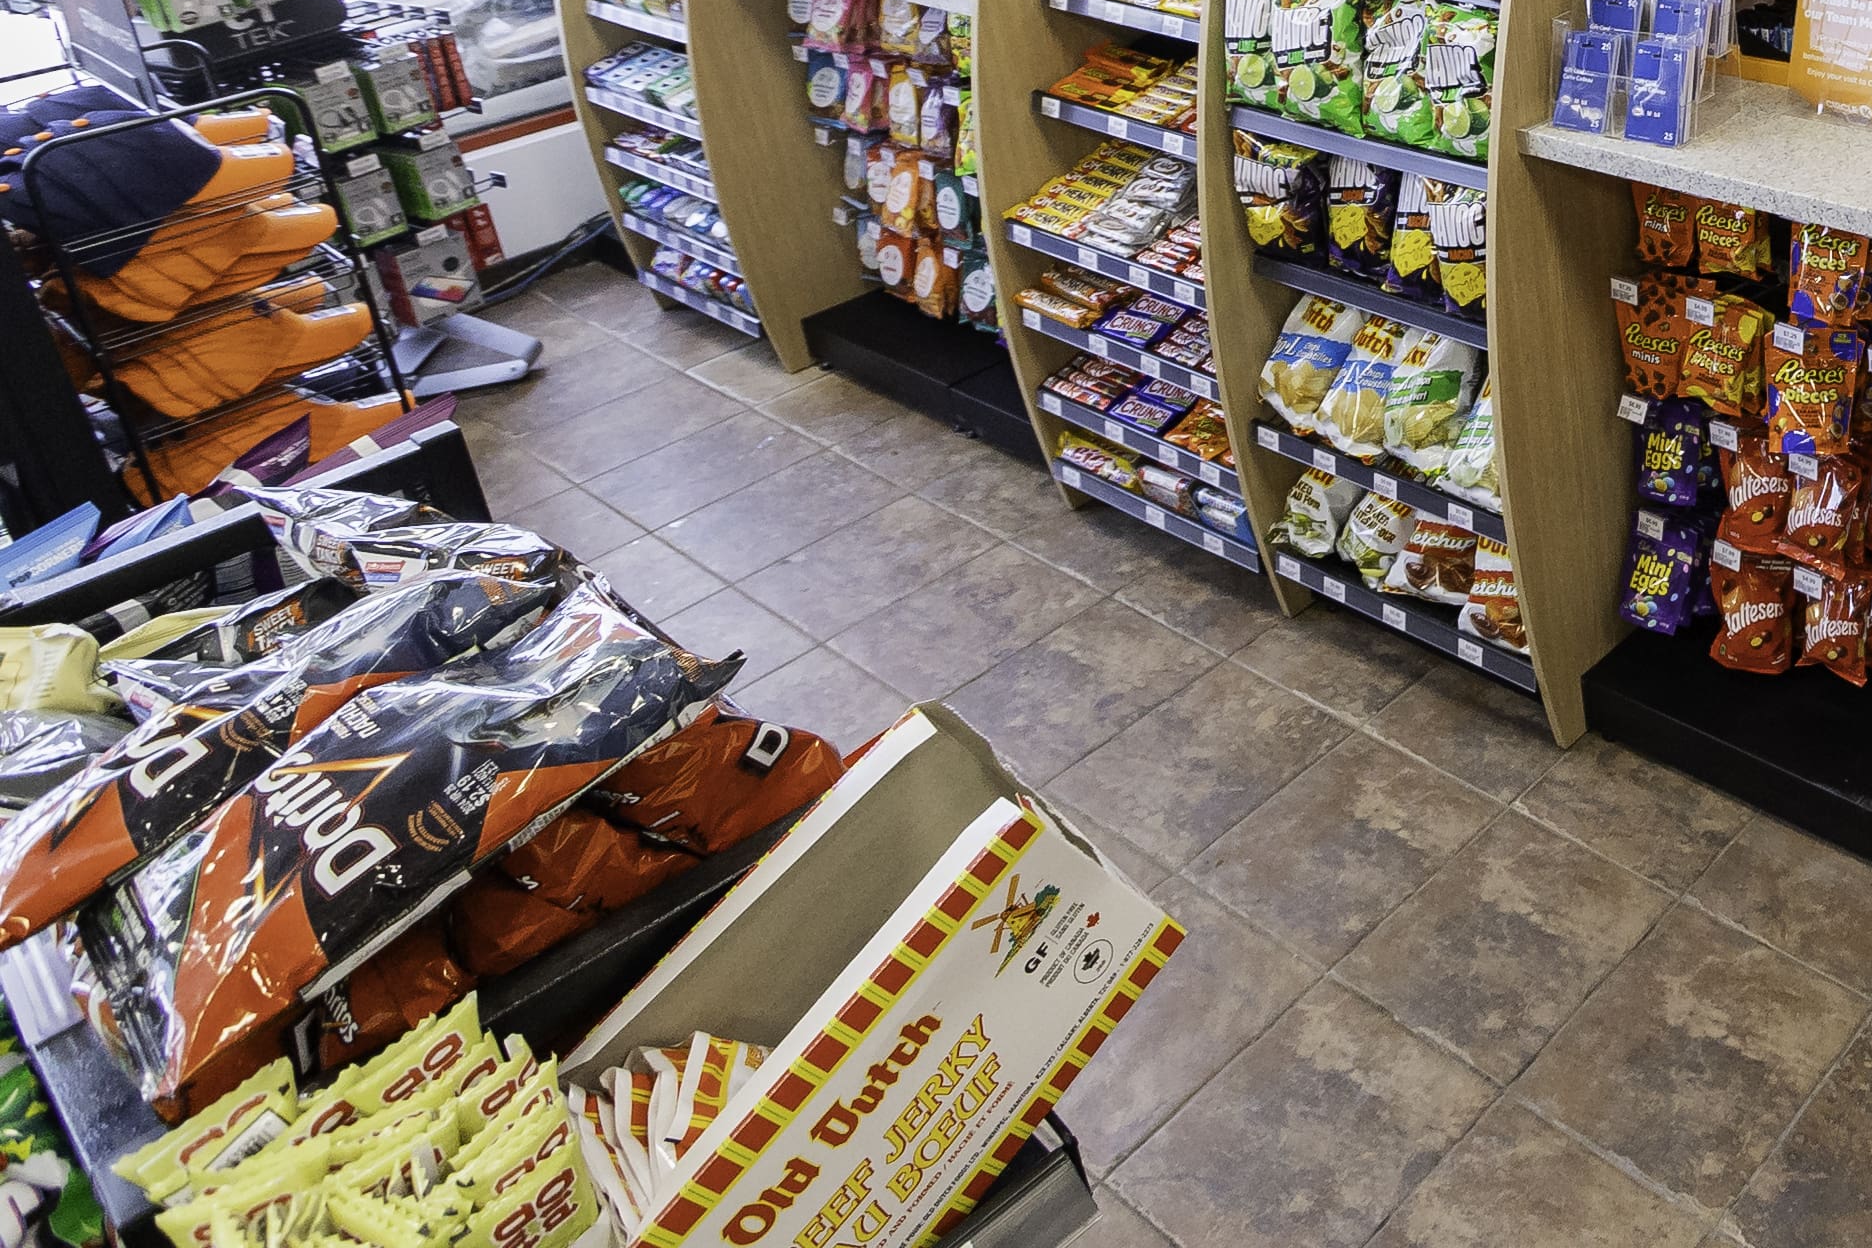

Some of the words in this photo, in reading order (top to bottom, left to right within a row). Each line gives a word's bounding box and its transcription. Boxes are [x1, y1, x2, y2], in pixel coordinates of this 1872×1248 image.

[1826, 10, 1857, 28] Team
[1664, 132, 1673, 140] 25
[1696, 205, 1750, 233] Reese's
[1700, 229, 1741, 248] pieces
[1134, 297, 1186, 321] CRUNCH
[1109, 316, 1160, 336] CRUNCH
[1625, 323, 1679, 354] Reese's
[1632, 349, 1661, 365] minis
[1774, 359, 1847, 383] Reese's
[1119, 400, 1173, 425] CRUNCH
[1647, 432, 1682, 453] Mini
[1645, 450, 1682, 471] Eggs
[1636, 554, 1674, 578] Mini
[1630, 574, 1670, 597] Eggs
[1024, 941, 1049, 974] GF
[882, 1012, 992, 1165] JERKY
[722, 1156, 821, 1246] Old
[808, 1013, 943, 1150] Dutch
